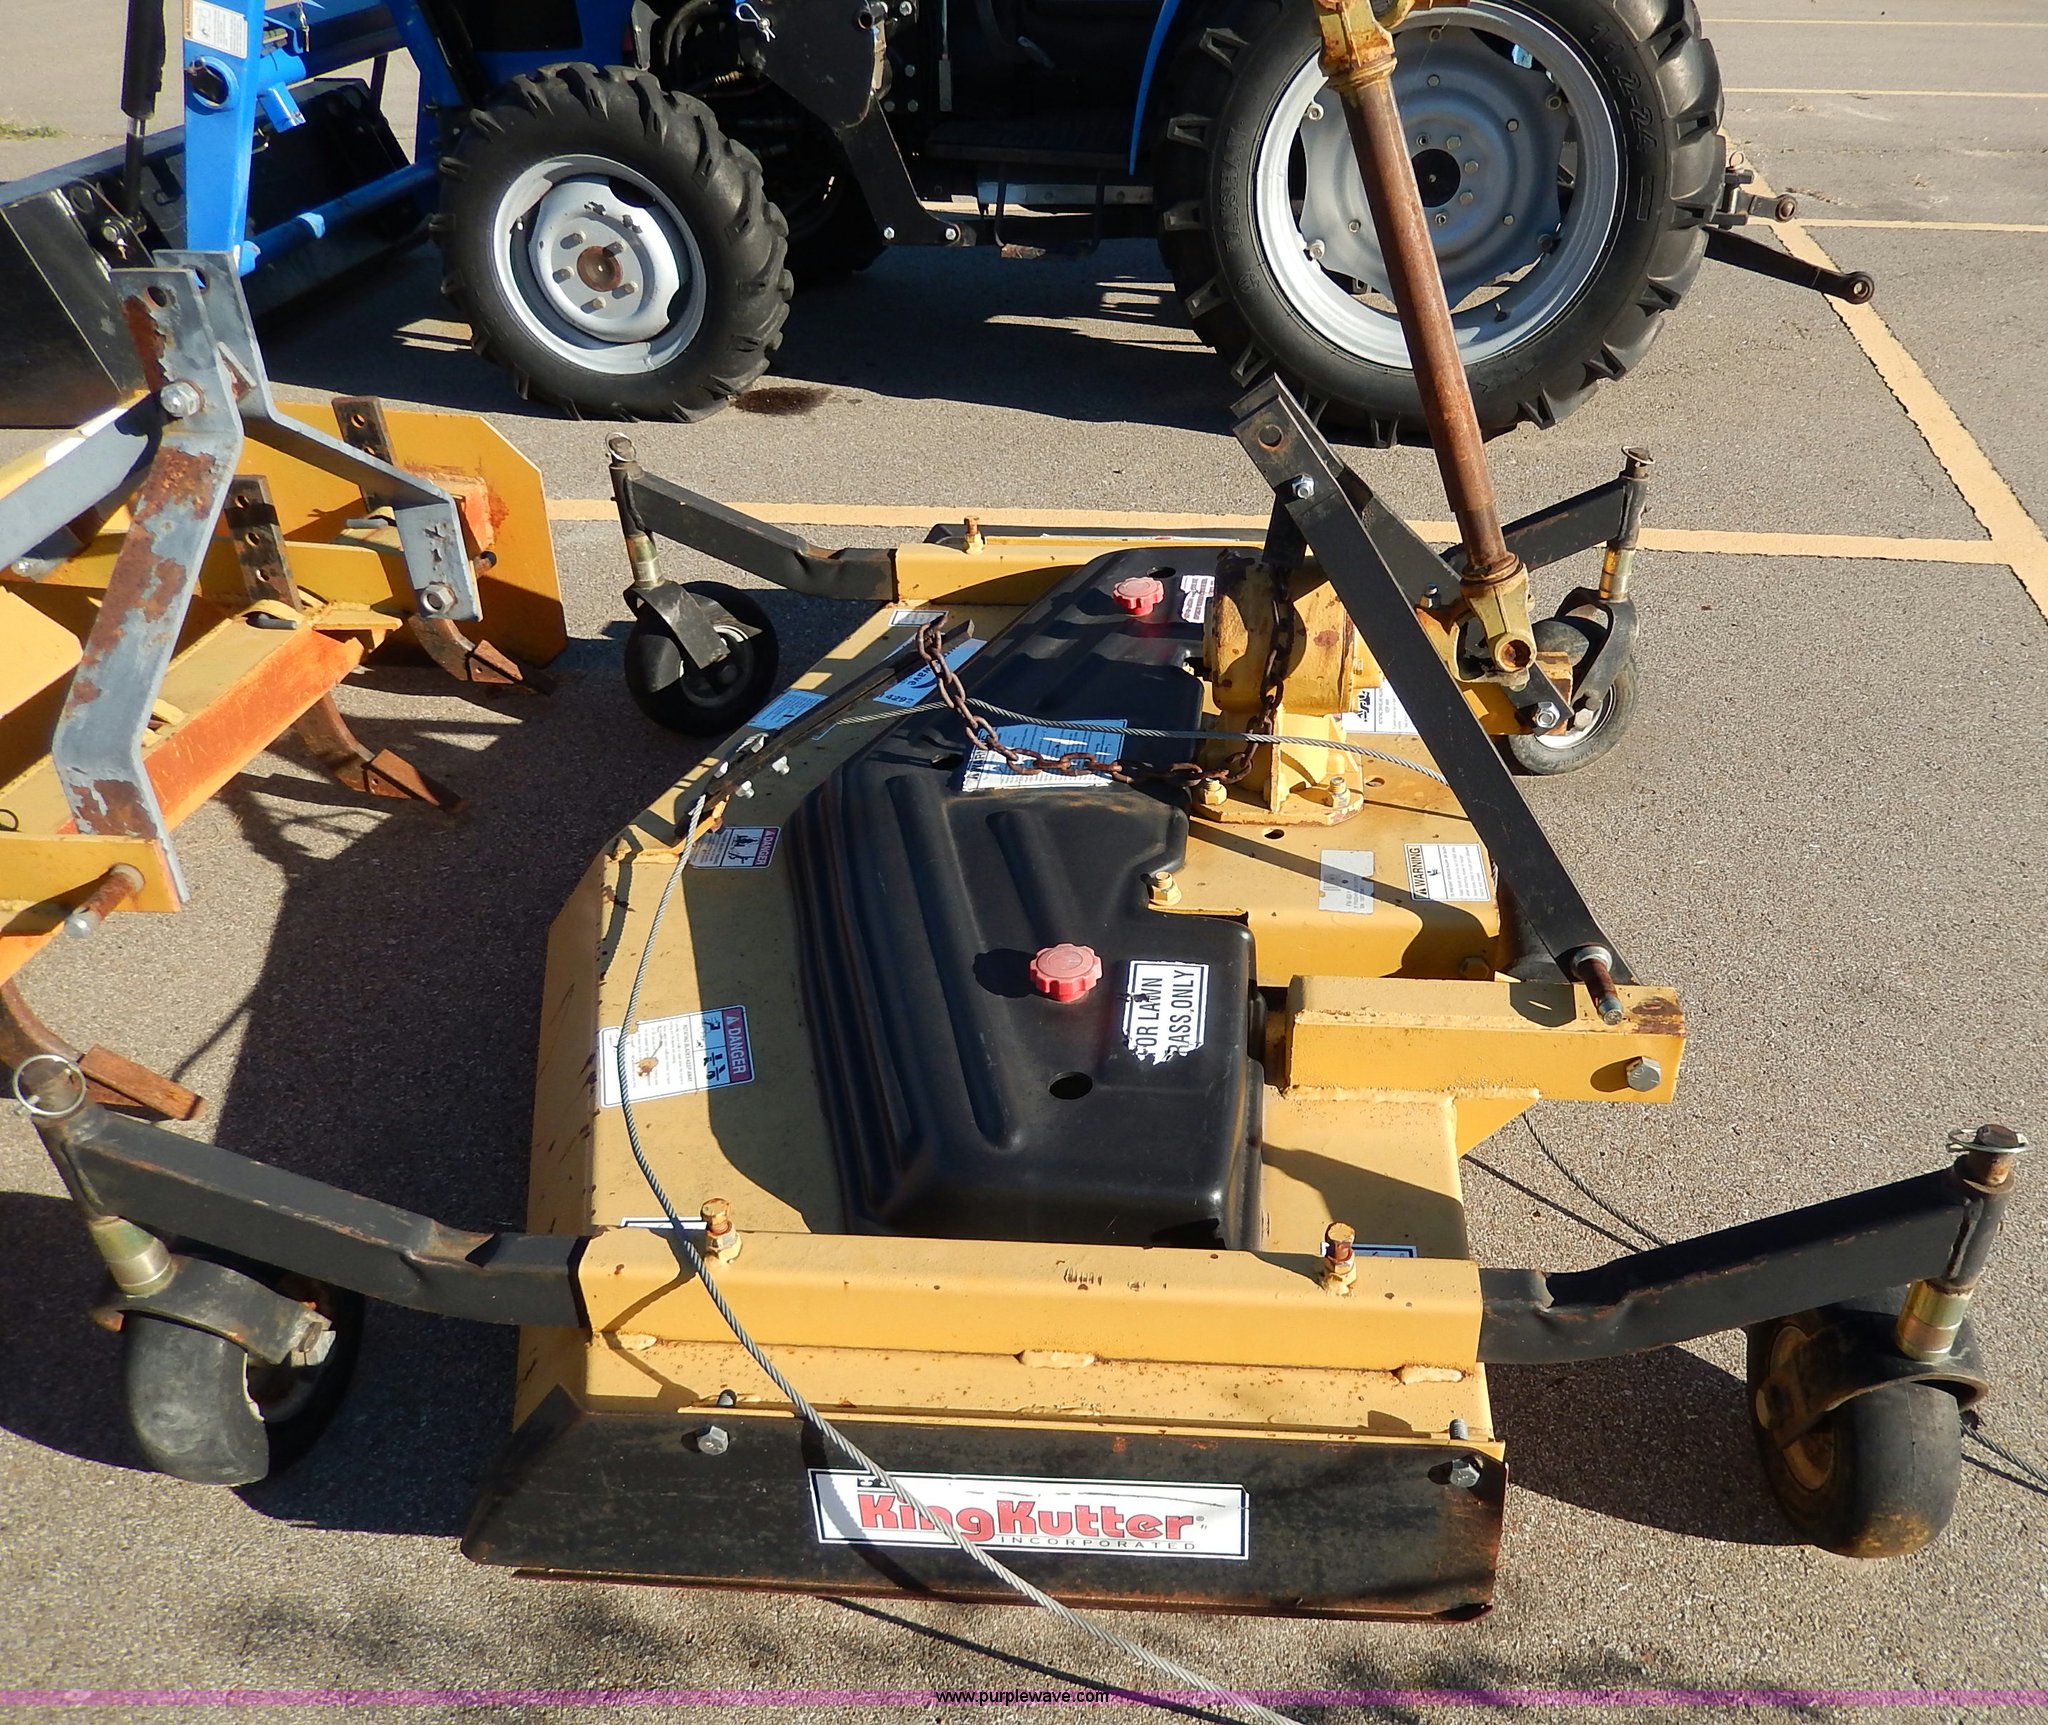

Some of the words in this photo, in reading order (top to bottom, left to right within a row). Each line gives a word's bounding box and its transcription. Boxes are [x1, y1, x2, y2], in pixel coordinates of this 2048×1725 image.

[1590, 24, 1657, 152] 11.2-24
[755, 836, 775, 865] DANGER
[1409, 847, 1427, 888] WARNING
[1138, 978, 1163, 1020] LAWN
[1171, 970, 1194, 1008] ONLY
[727, 1027, 746, 1074] DANGER
[1167, 1014, 1192, 1058] RASS
[1000, 1535, 1196, 1551] INCORPORATED
